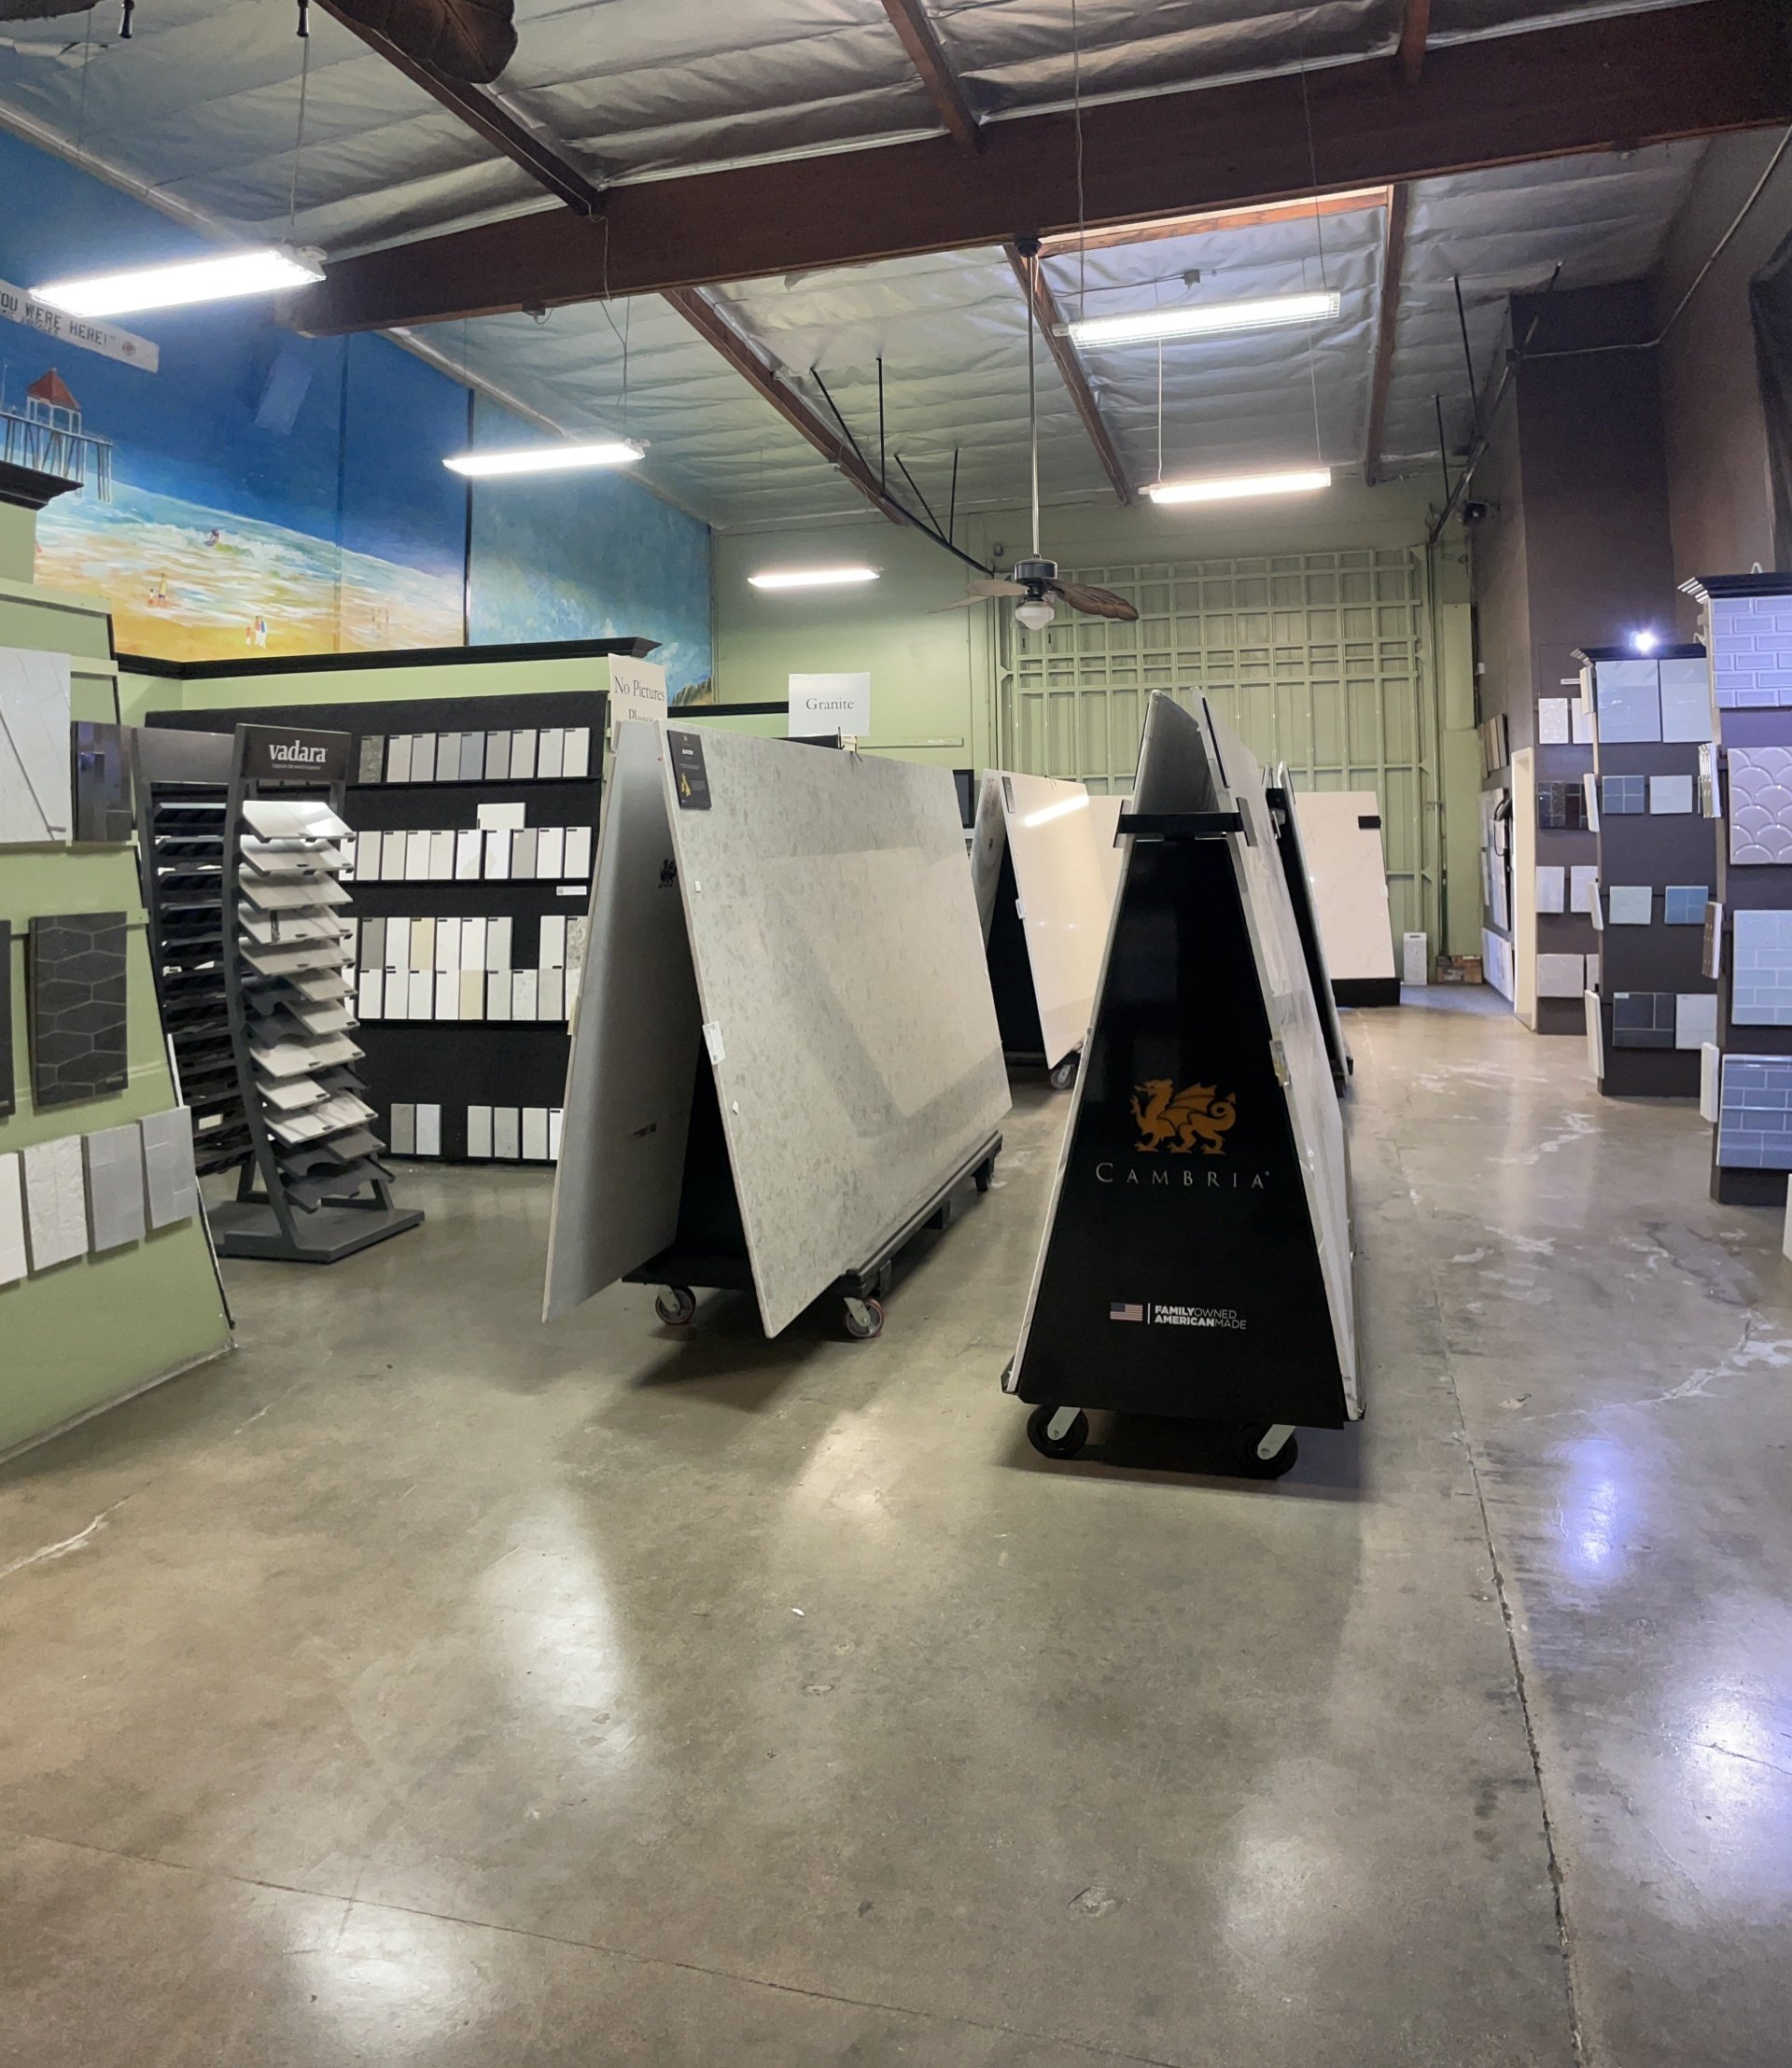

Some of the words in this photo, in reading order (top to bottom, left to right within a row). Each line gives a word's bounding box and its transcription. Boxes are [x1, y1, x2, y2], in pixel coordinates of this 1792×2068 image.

[0, 290, 18, 312] OU
[25, 301, 62, 328] WERE
[614, 676, 630, 695] No
[633, 679, 665, 702] Pictures
[805, 696, 855, 710] Granite
[269, 740, 326, 762] vadara
